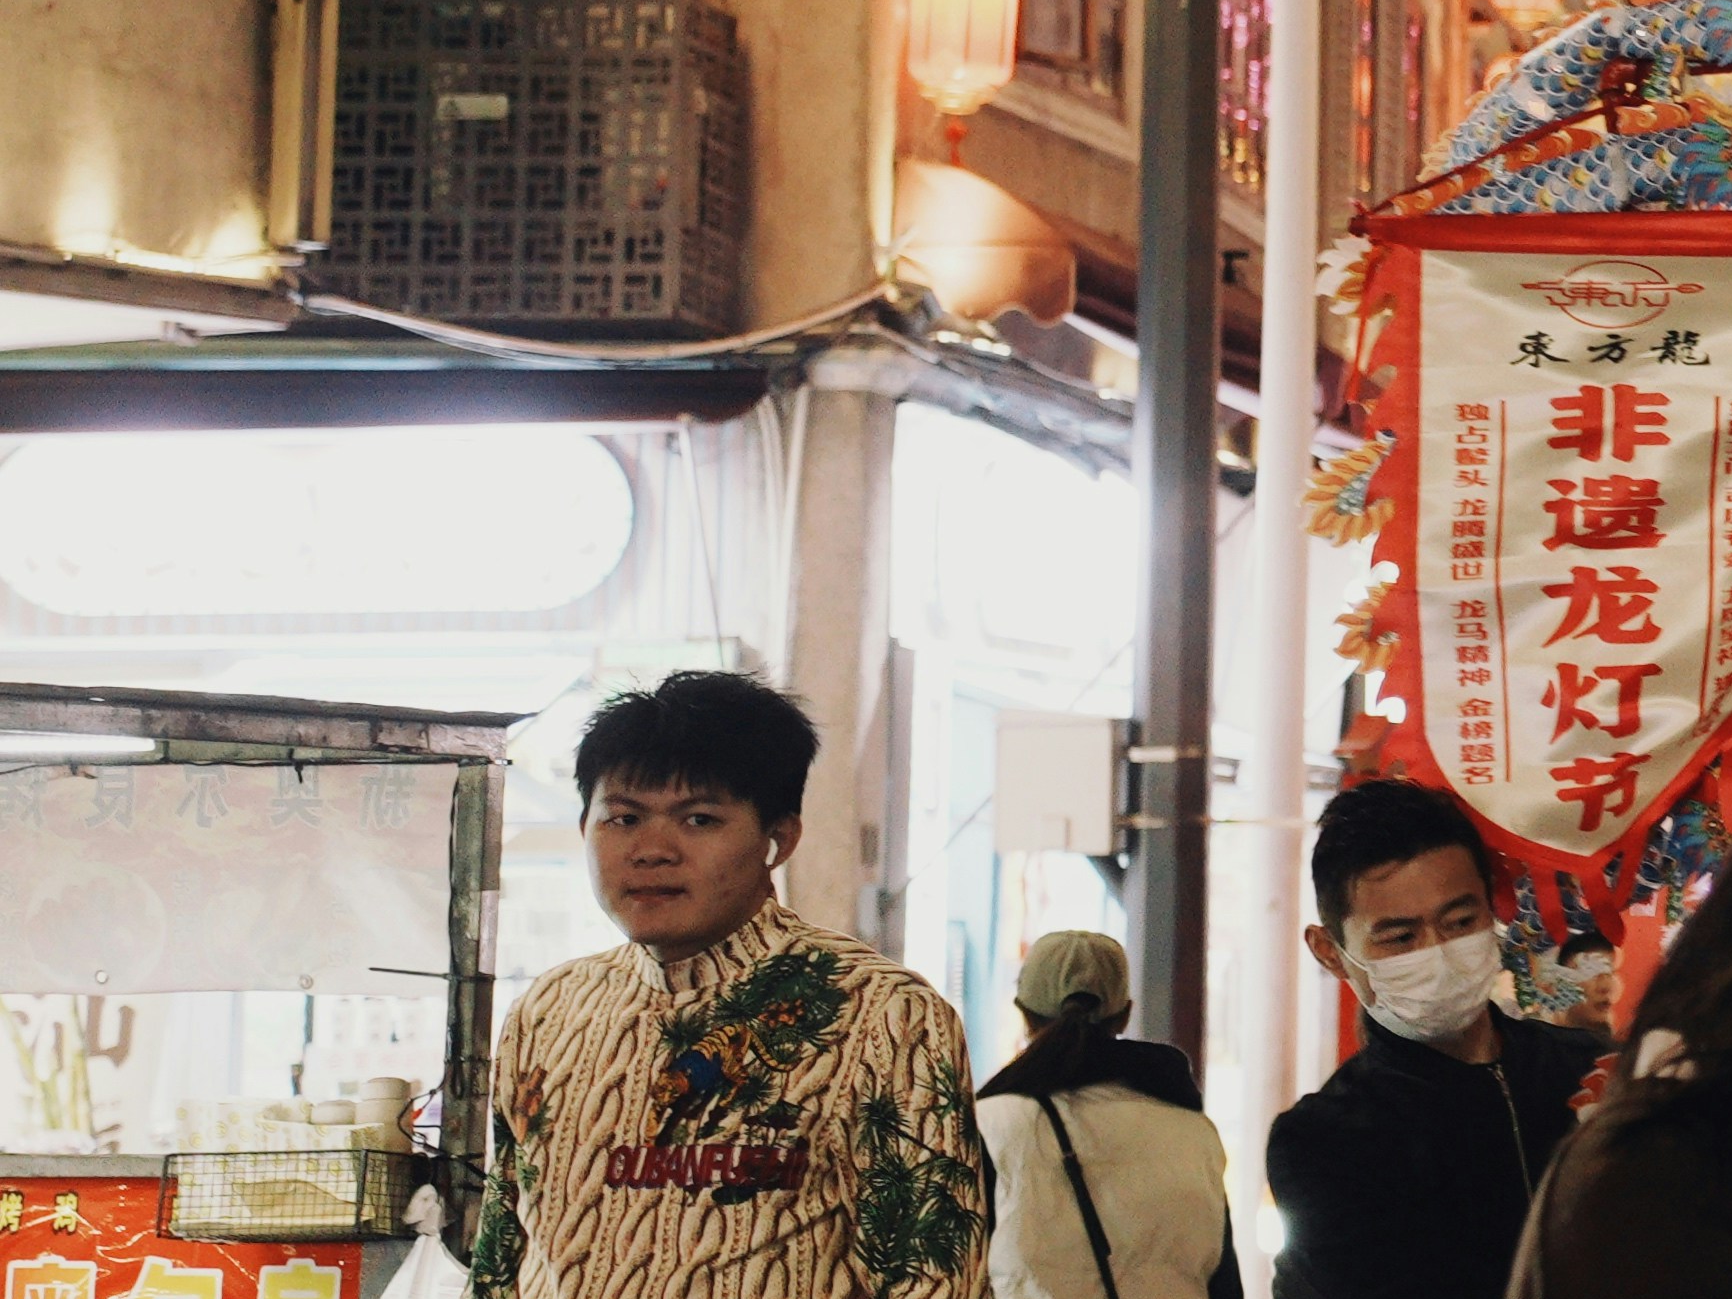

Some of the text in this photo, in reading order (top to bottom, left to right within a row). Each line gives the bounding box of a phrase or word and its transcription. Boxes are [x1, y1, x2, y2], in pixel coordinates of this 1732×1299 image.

[1509, 330, 1711, 367] 東方龍
[1451, 498, 1488, 581] 龙腾盛世
[1450, 599, 1492, 687] 龙马精神
[1541, 384, 1671, 833] 非遗龙灯节
[1458, 697, 1497, 785] 金榜题名
